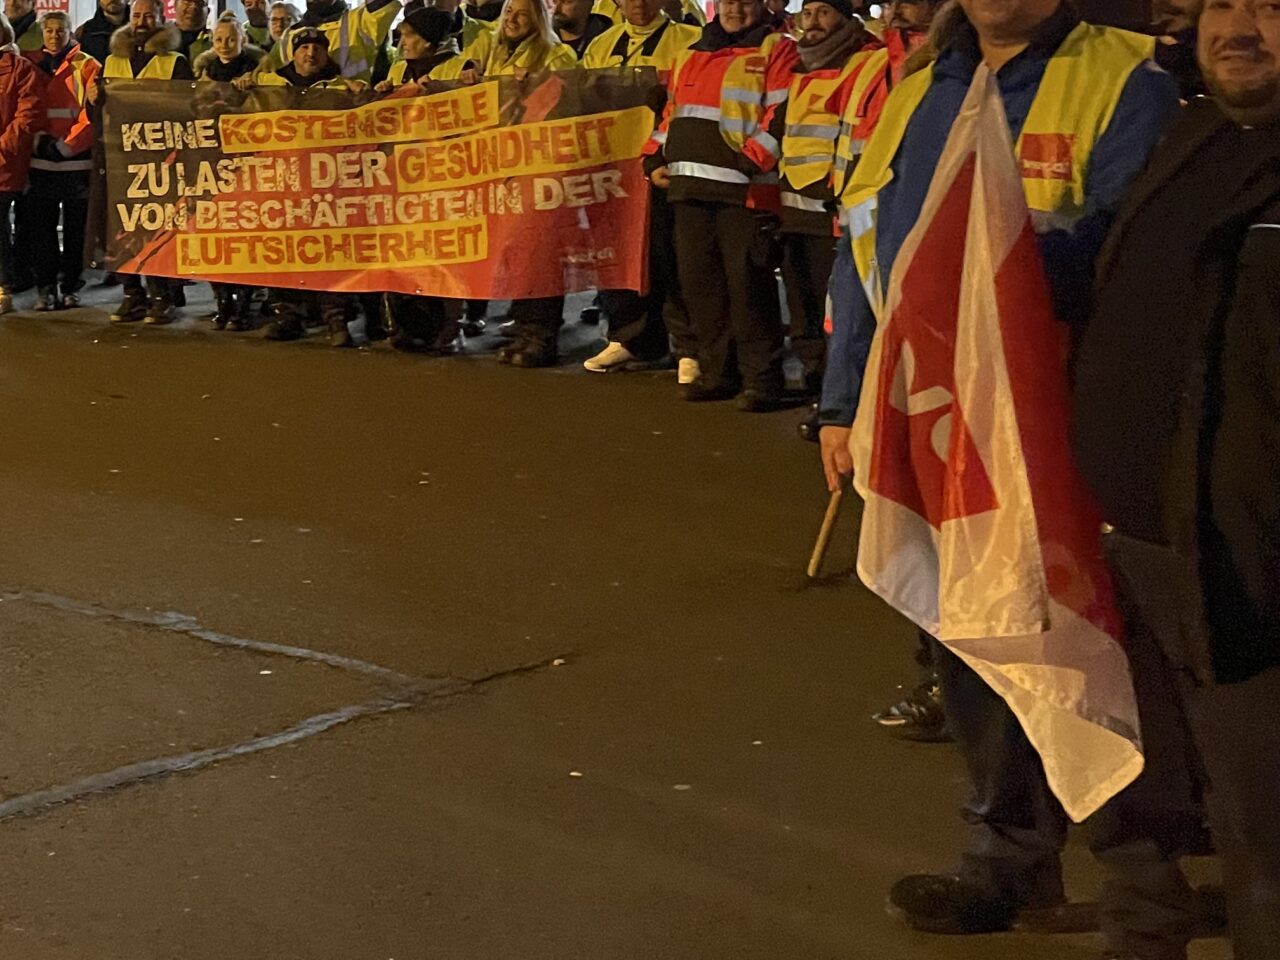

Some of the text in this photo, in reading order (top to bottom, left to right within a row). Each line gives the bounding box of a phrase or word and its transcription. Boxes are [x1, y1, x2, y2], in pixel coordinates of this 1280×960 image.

[121, 90, 489, 152] KEINE KOSTENSPIELE
[126, 117, 615, 199] ZU LASTEN DER GESUNDHEIT
[116, 169, 629, 232] VON BESCHÄFTIGTEN IN DER
[180, 224, 483, 268] LUFTSICHERHEIT
